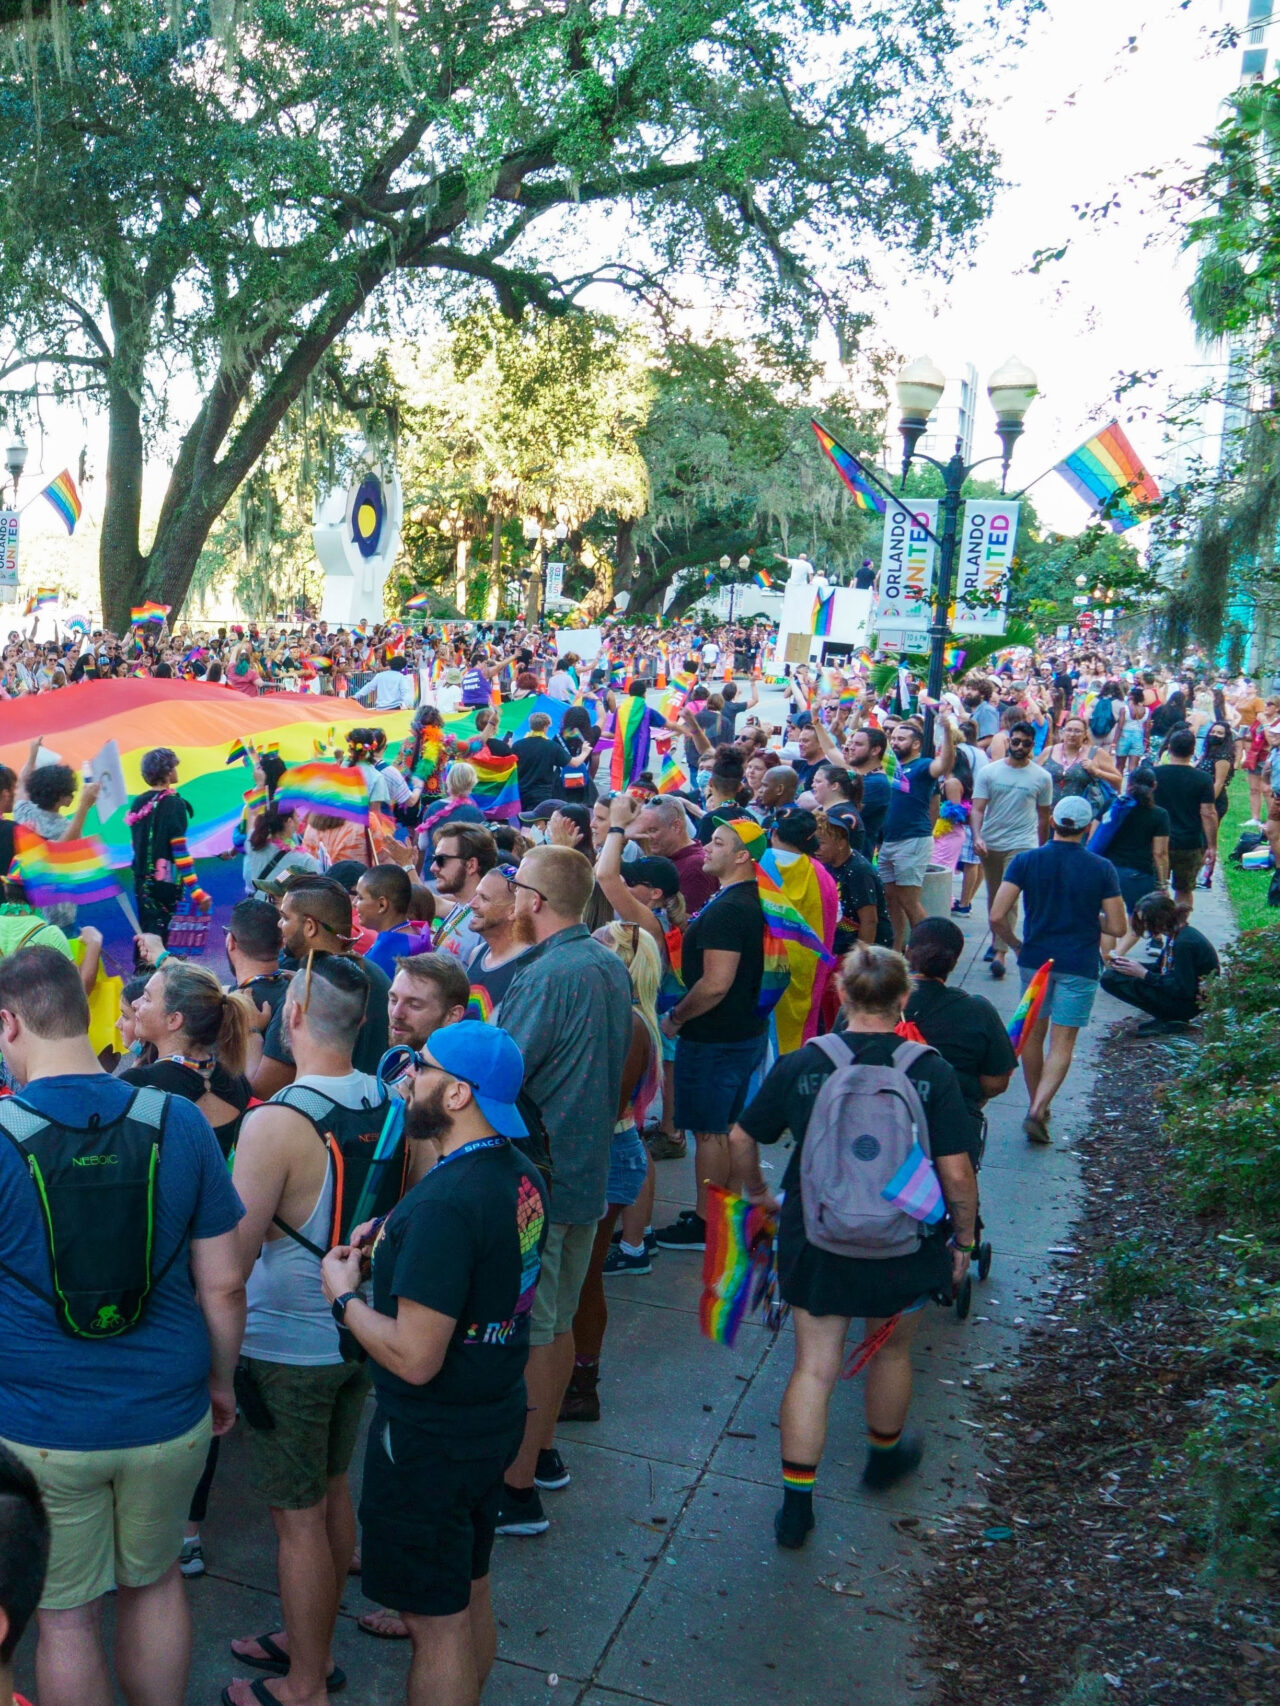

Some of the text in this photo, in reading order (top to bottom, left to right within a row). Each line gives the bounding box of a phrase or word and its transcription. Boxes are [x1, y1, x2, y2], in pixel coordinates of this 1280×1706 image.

[6, 518, 18, 570] UNITED
[885, 512, 907, 599] ORLANDO
[903, 512, 930, 600] UNITED
[553, 566, 561, 594] UNITED
